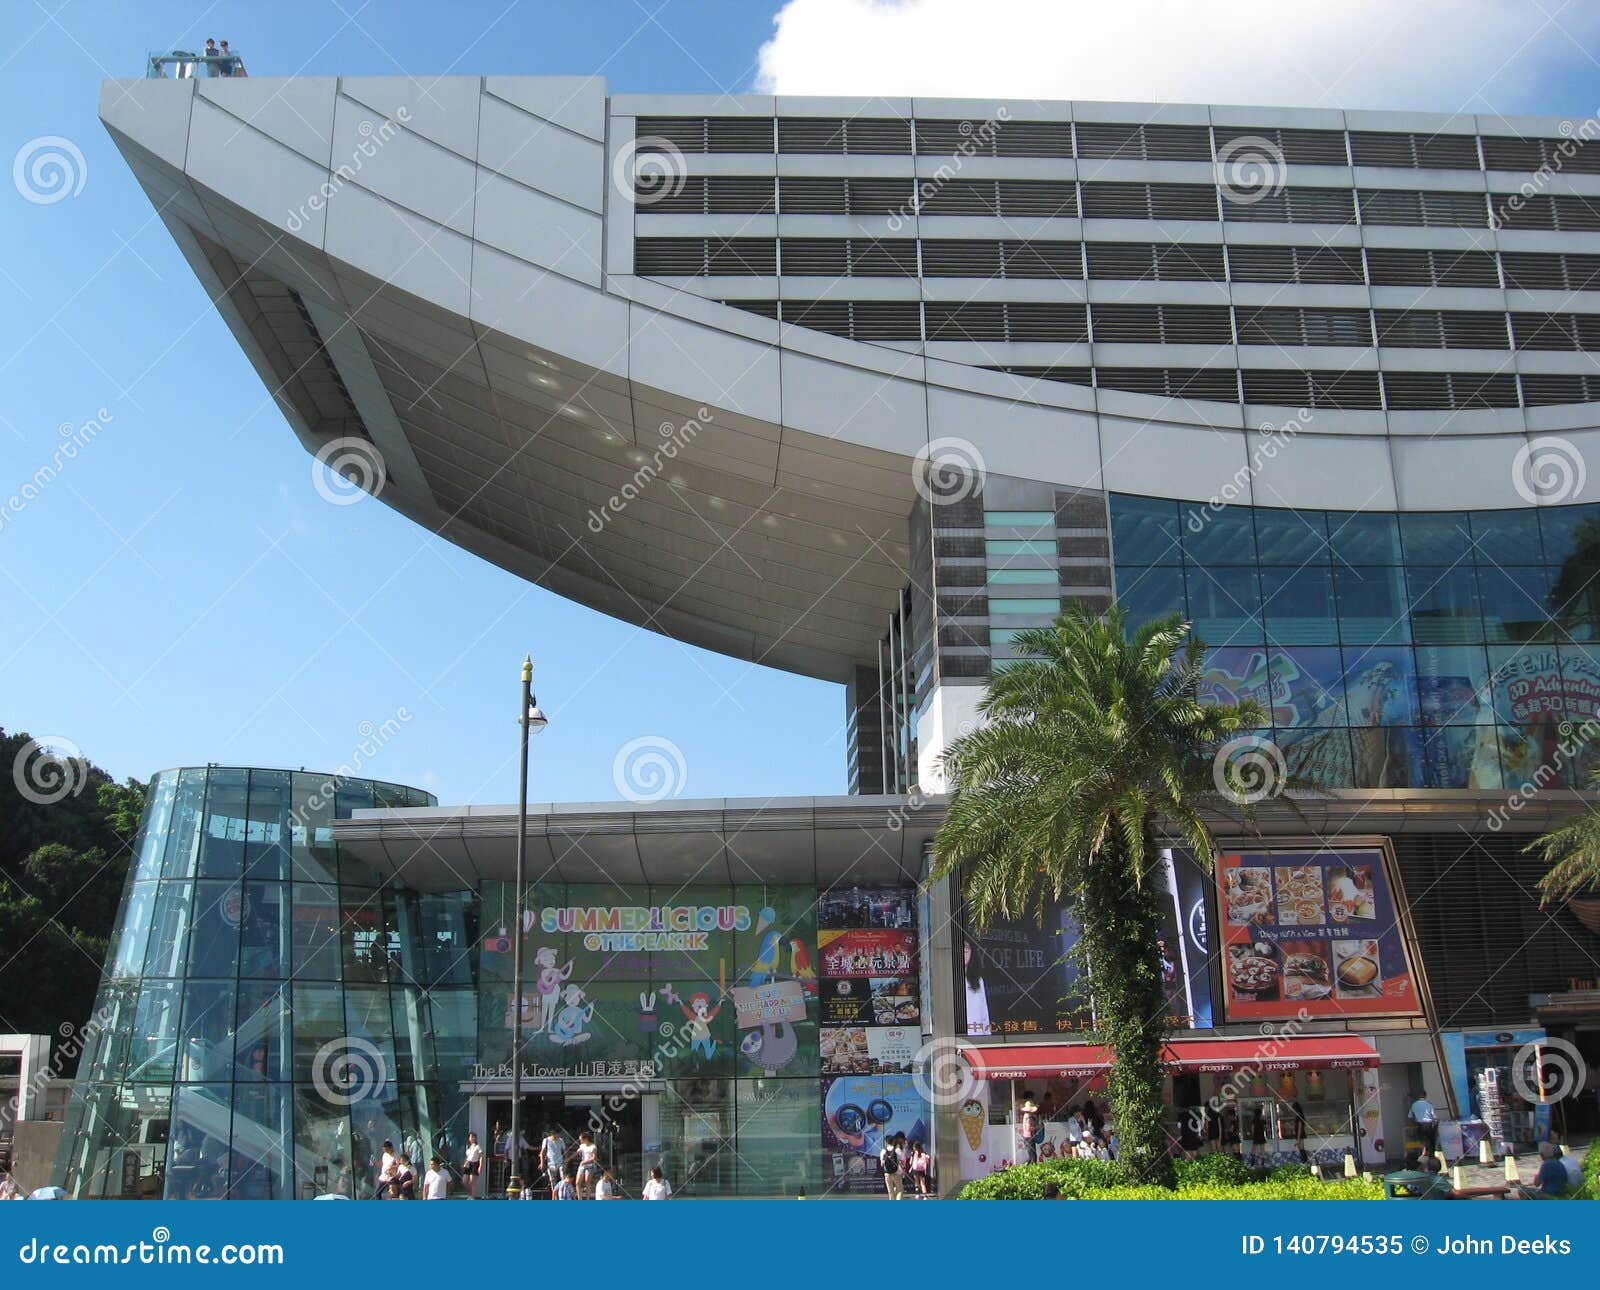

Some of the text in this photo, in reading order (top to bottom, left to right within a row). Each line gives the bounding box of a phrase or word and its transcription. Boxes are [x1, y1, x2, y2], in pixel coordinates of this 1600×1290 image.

[1014, 947, 1045, 968] LIFE
[473, 1064, 570, 1077] The Pek Tower
[574, 1060, 656, 1077] 山頂凌霄閣
